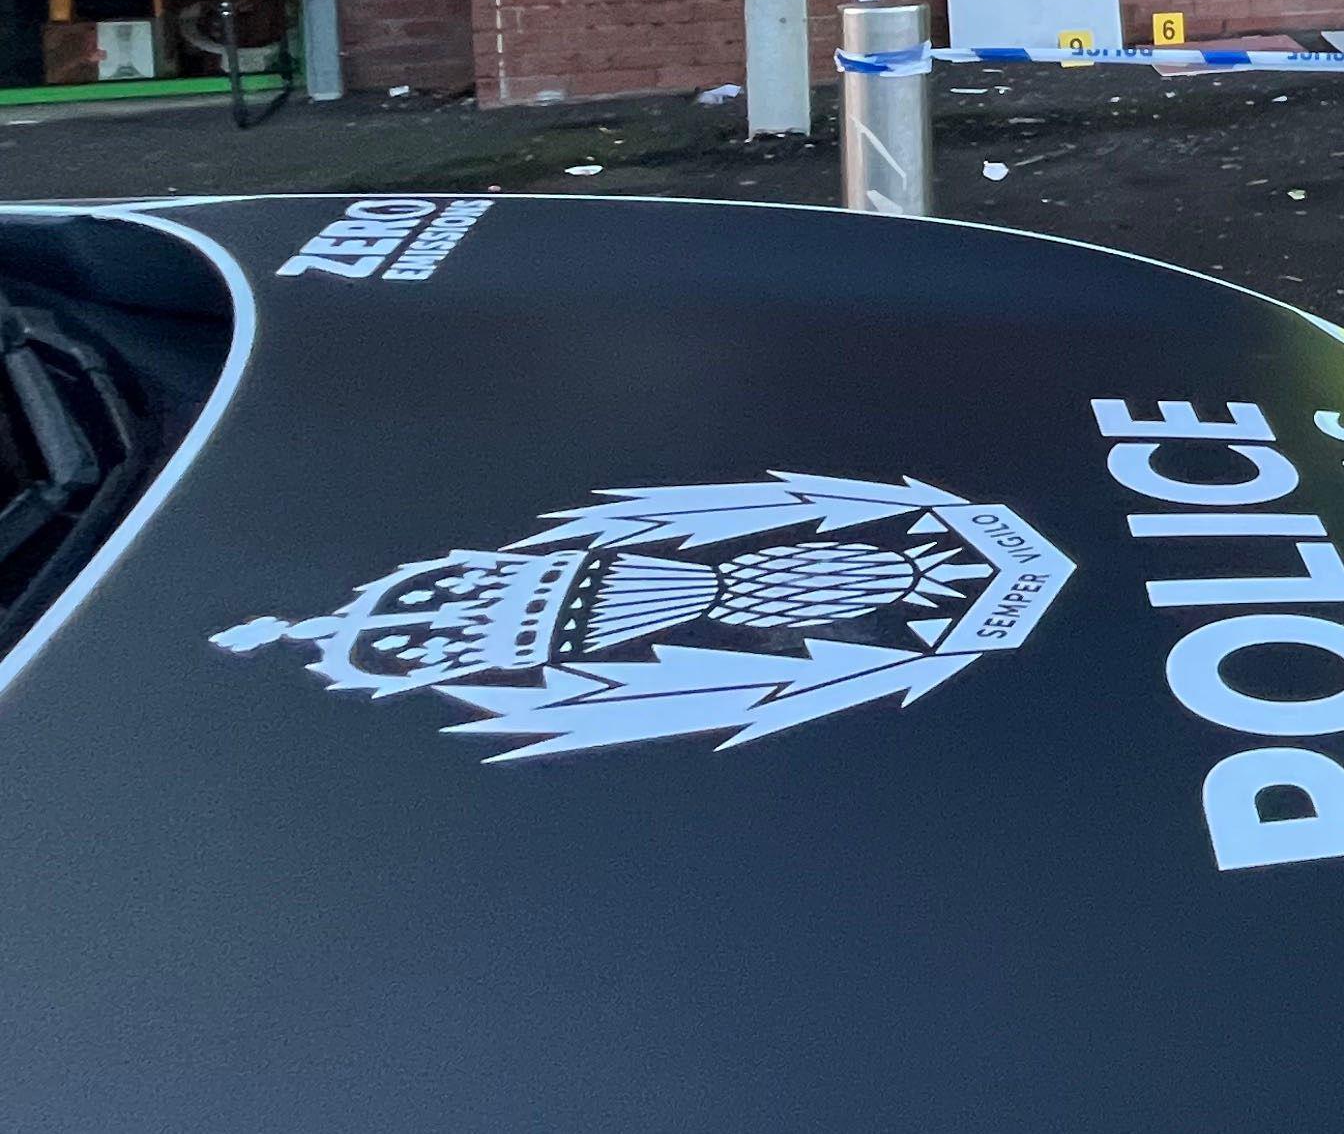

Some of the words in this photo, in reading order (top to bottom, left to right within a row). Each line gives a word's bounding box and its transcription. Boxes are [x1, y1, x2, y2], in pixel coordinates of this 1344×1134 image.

[1162, 19, 1175, 40] 6
[275, 198, 438, 278] ZERO
[381, 198, 496, 281] EMISSIONS
[971, 514, 1042, 564] VIGILO
[976, 572, 1051, 639] SEMPER
